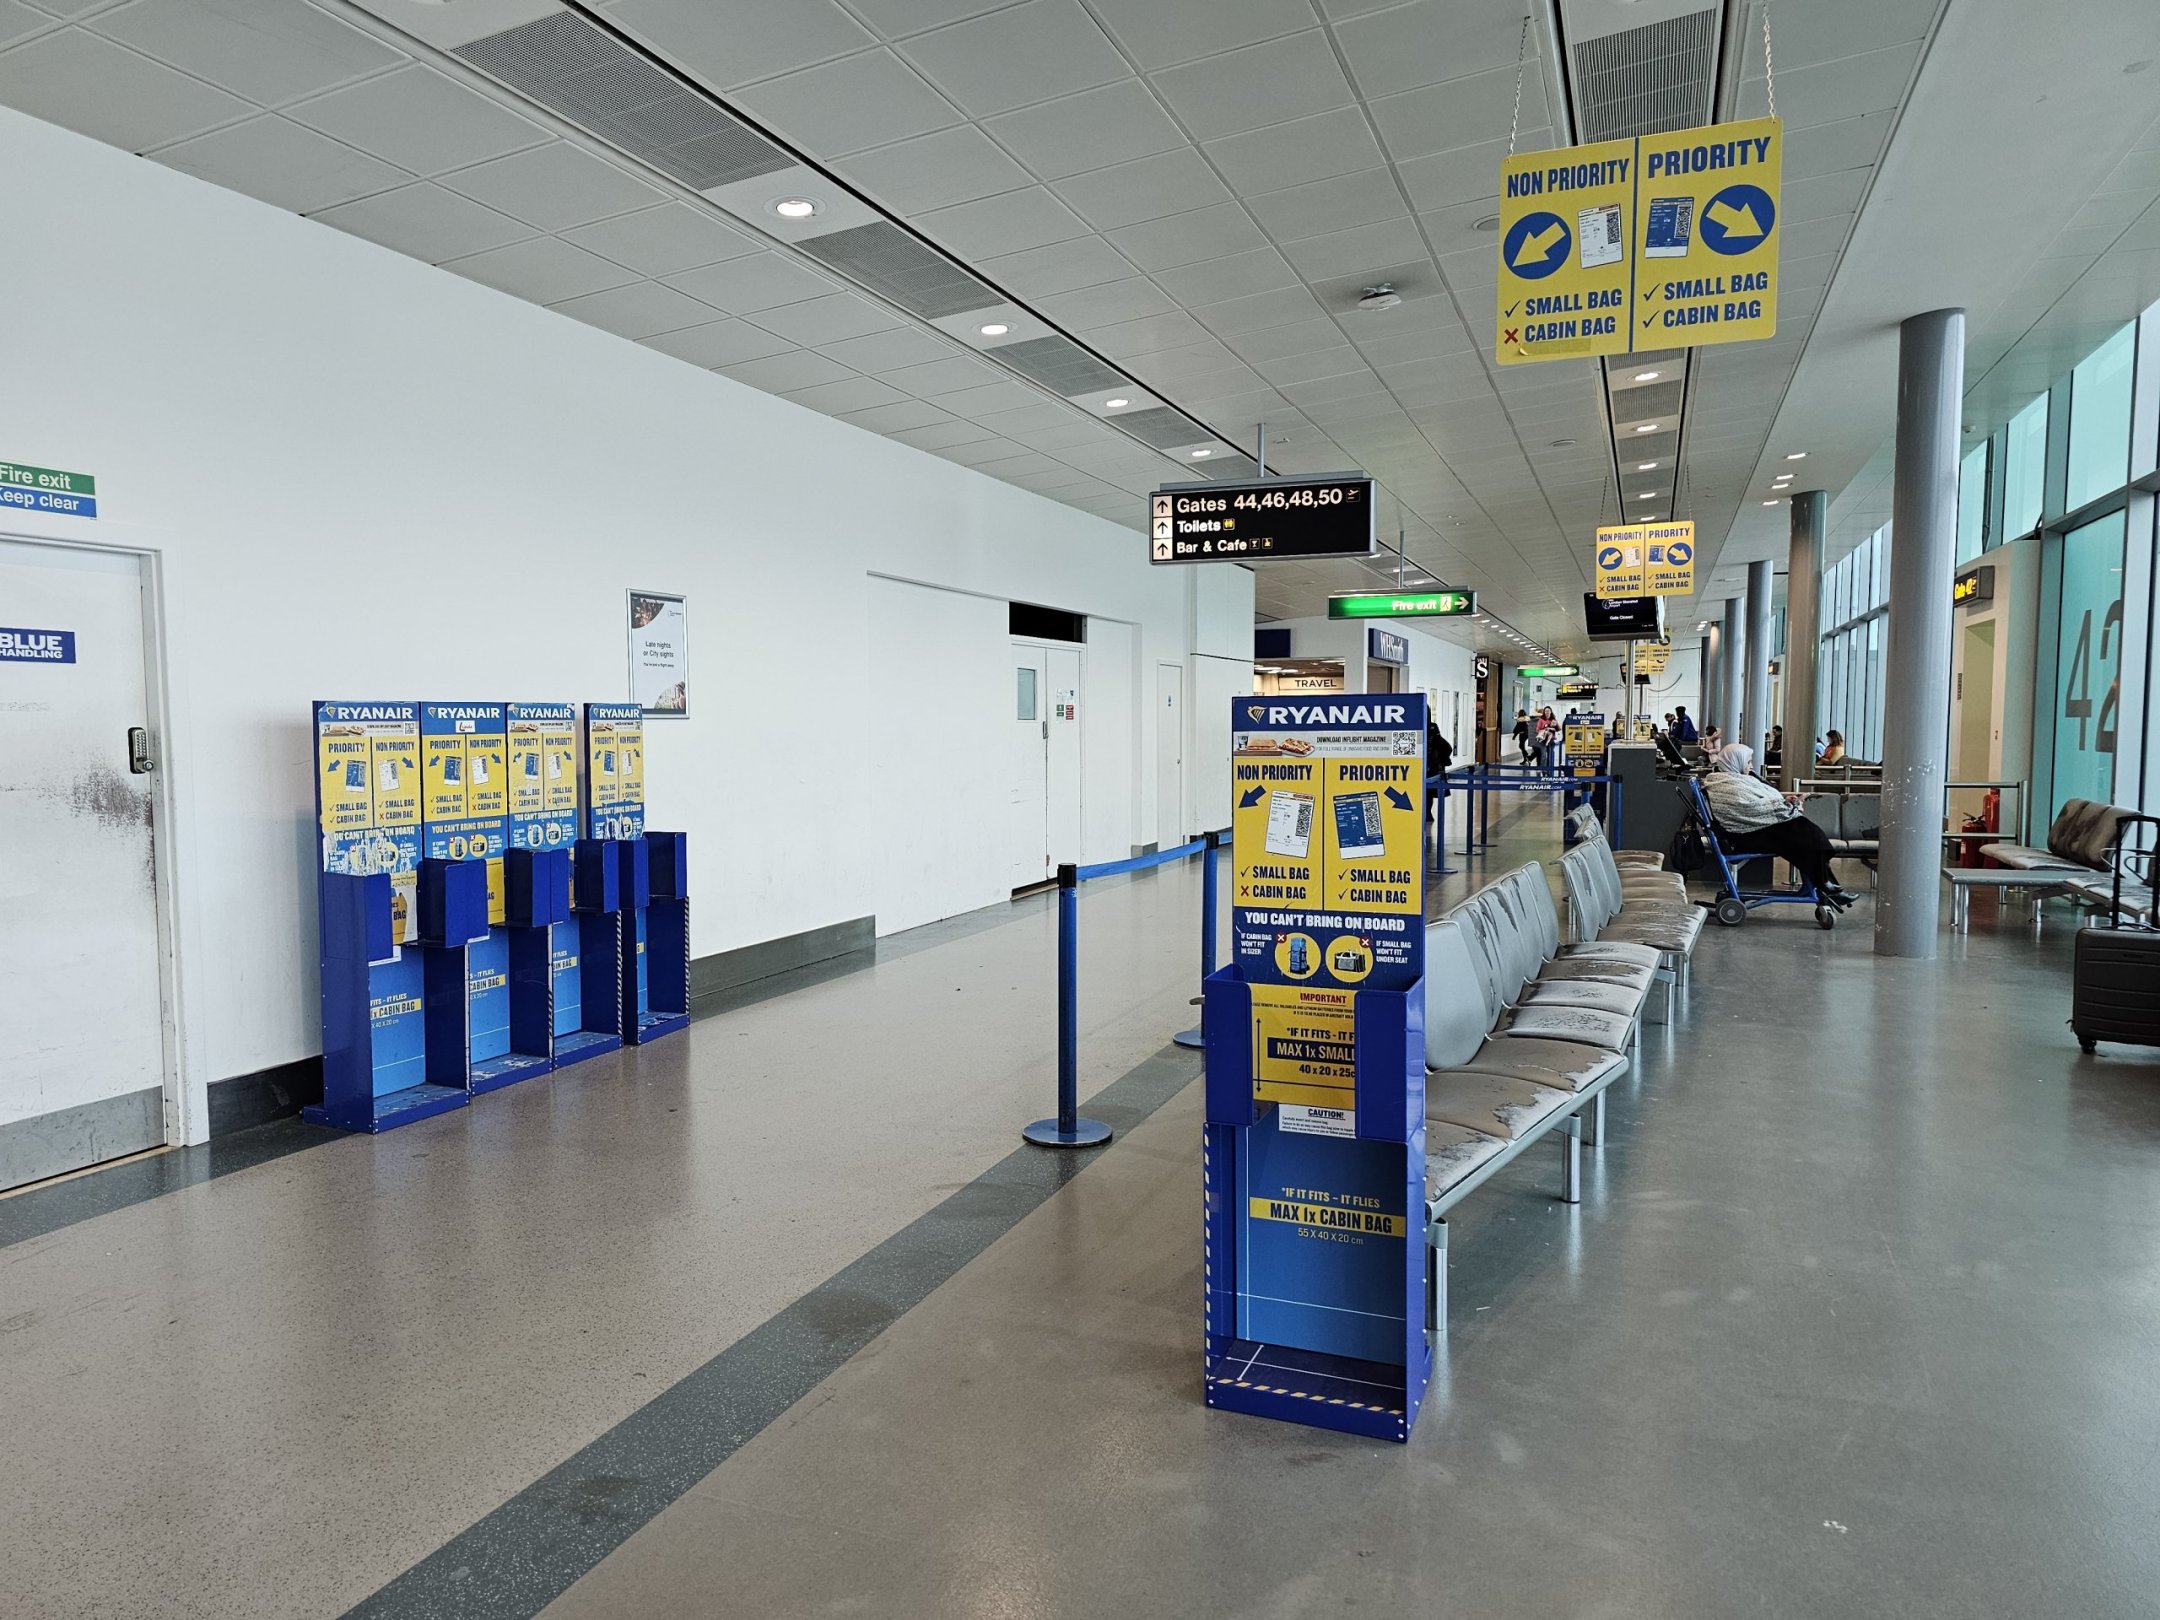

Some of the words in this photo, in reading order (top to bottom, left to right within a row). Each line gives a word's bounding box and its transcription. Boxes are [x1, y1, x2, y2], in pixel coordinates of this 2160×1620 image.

[1648, 136, 1772, 179] PRIORITY
[1507, 170, 1543, 198] NON
[1547, 158, 1630, 193] PRIORITY
[1664, 278, 1725, 301] SMALL
[1730, 271, 1768, 292] BAG
[1525, 293, 1583, 317] SMALL
[1587, 289, 1623, 308] BAG
[1663, 305, 1720, 328] CABIN
[1724, 300, 1761, 321] BAG
[1524, 320, 1577, 343] CABIN
[1581, 316, 1616, 335] BAG
[0, 464, 33, 484] Fire
[38, 473, 71, 490] exit
[39, 493, 79, 511] clear
[1176, 497, 1227, 514] Gates
[1234, 488, 1343, 512] 44,46,48,50
[1177, 519, 1221, 534] Toilets
[1648, 527, 1690, 539] PRIORITY
[1599, 533, 1612, 542] NON
[1613, 531, 1643, 541] PRIORITY
[1176, 541, 1198, 554] Bar
[1202, 540, 1212, 552] &
[1217, 539, 1247, 552] Cafe
[1606, 575, 1627, 583] SMALL
[1628, 574, 1641, 582] BAG
[1655, 572, 1676, 580] SMALL
[1677, 571, 1691, 579] BAG
[1392, 600, 1414, 611] Fire
[1416, 599, 1436, 610] exit
[0, 632, 63, 651] BLUE
[0, 648, 63, 659] HANDLING
[1476, 662, 1488, 679] S
[2065, 599, 2125, 753] 42
[1294, 679, 1337, 688] TRAVEL
[337, 707, 413, 720] RYANAIR
[437, 707, 500, 719] RYANAIR
[520, 707, 571, 719] RYANAIR
[599, 708, 640, 719] RYANAIR
[1269, 705, 1405, 725] RYANAIR
[328, 742, 365, 753] PRIORITY
[375, 742, 388, 752] NON
[389, 741, 414, 751] PRIORITY
[430, 740, 461, 749] PRIORITY
[513, 738, 538, 746] PRIORITY
[1237, 765, 1260, 781] NON
[1261, 765, 1313, 781] PRIORITY
[1339, 765, 1410, 781] PRIORITY
[335, 803, 354, 812] SMALL
[385, 800, 403, 808] SMALL
[404, 799, 415, 807] BAG
[336, 815, 354, 824] CABIN
[354, 814, 366, 822] BAG
[385, 811, 402, 820] CABIN
[402, 810, 413, 818] BAG
[1252, 866, 1286, 880] SMALL
[1289, 866, 1309, 880] BAG
[1350, 869, 1386, 884] SMALL
[1389, 870, 1411, 884] BAG
[1252, 885, 1284, 899] CABIN
[1286, 885, 1306, 900] BAG
[1350, 888, 1382, 903] CABIN
[1385, 890, 1407, 904] BAG
[393, 910, 406, 921] BAG
[1245, 912, 1268, 925] YOU
[1270, 913, 1302, 927] CAN'T
[1306, 916, 1343, 929] BRING
[1345, 917, 1363, 929] ON
[1363, 917, 1405, 932] BOARD
[1382, 940, 1399, 948] SMALL
[1400, 941, 1412, 949] BAG
[1376, 948, 1393, 956] WON'T
[487, 977, 500, 987] BAG
[1300, 992, 1347, 1004] IMPORTANT
[379, 1004, 400, 1017] CABIN
[401, 1001, 415, 1012] BAG
[1300, 1028, 1310, 1038] IT
[1312, 1029, 1331, 1040] FITS
[1338, 1031, 1348, 1040] IT
[1276, 1041, 1302, 1057] MAX
[1305, 1045, 1316, 1059] 1x
[1299, 1064, 1311, 1074] 40
[1319, 1065, 1331, 1076] 20
[1308, 1108, 1344, 1118] CAUTION!
[1296, 1189, 1307, 1199] IT
[1308, 1190, 1330, 1201] FITS
[1340, 1194, 1351, 1205] IT
[1353, 1196, 1380, 1209] FLIES
[1270, 1202, 1300, 1221] MAX
[1304, 1206, 1316, 1223] 1x
[1319, 1211, 1361, 1230] CABIN
[1364, 1215, 1392, 1234] BAG
[1297, 1227, 1309, 1238] 55
[1310, 1229, 1317, 1239] X
[1317, 1230, 1330, 1241] 40
[1330, 1232, 1338, 1242] X
[1338, 1233, 1350, 1243] 20
[1351, 1236, 1364, 1245] cm
